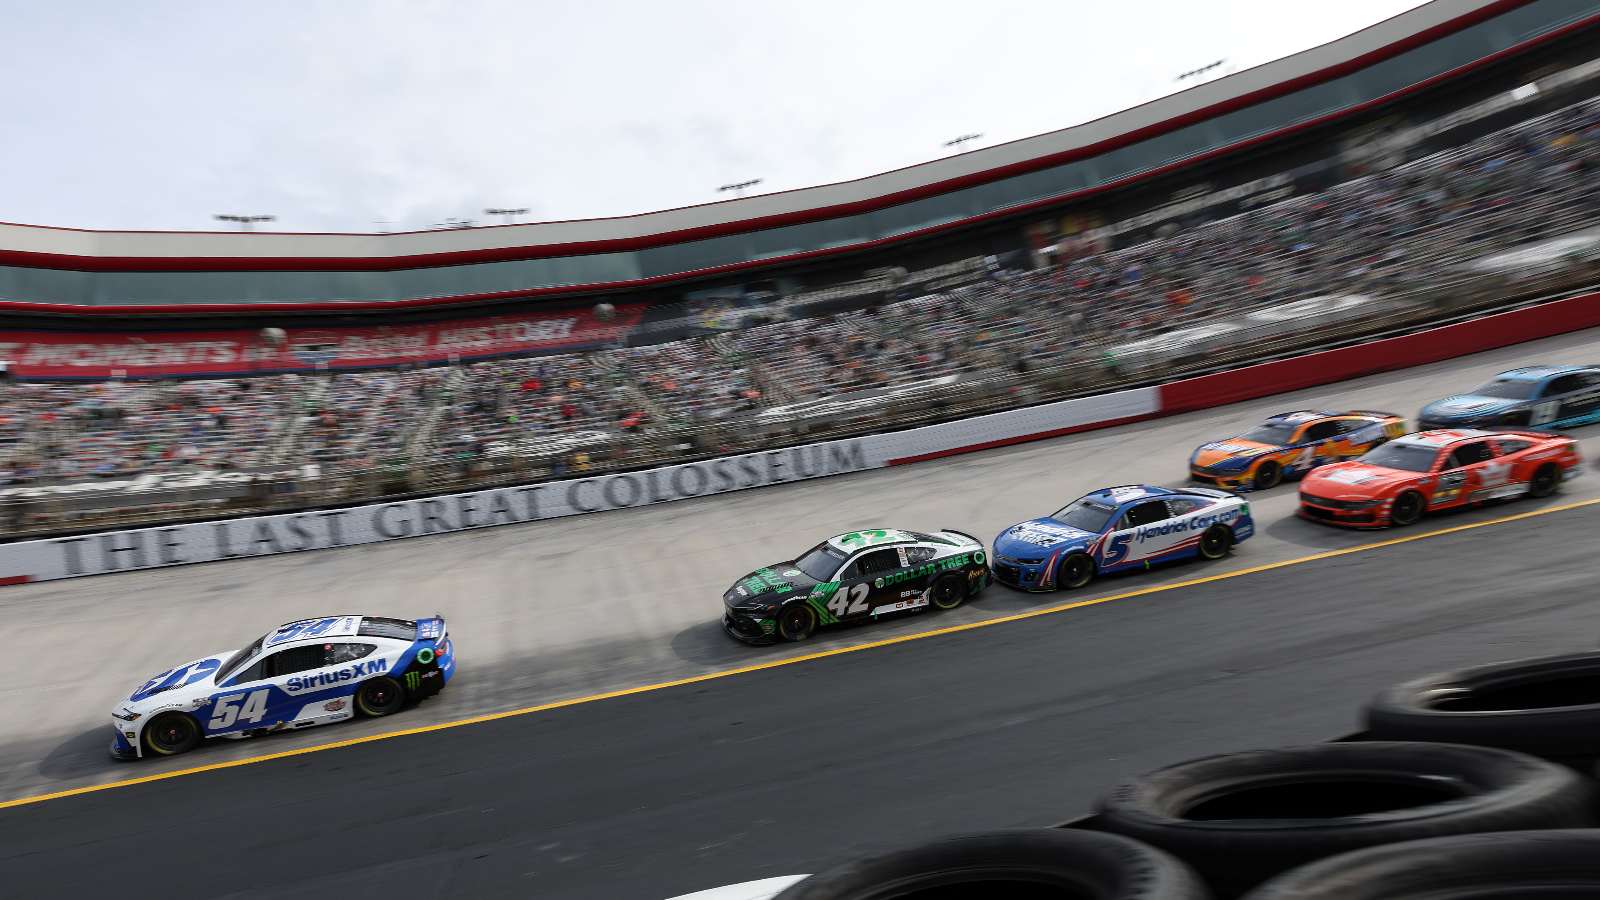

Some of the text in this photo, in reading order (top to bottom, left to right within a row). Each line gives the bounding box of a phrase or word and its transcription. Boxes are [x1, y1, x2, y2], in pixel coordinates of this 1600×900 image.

[52, 439, 867, 575] THE LAST GREAT COLOSSEUM
[1102, 533, 1132, 567] 5
[884, 555, 970, 585] DOLLAR TREE
[827, 583, 870, 616] 42
[286, 658, 387, 692] SiriusXM
[208, 688, 270, 730] 54
